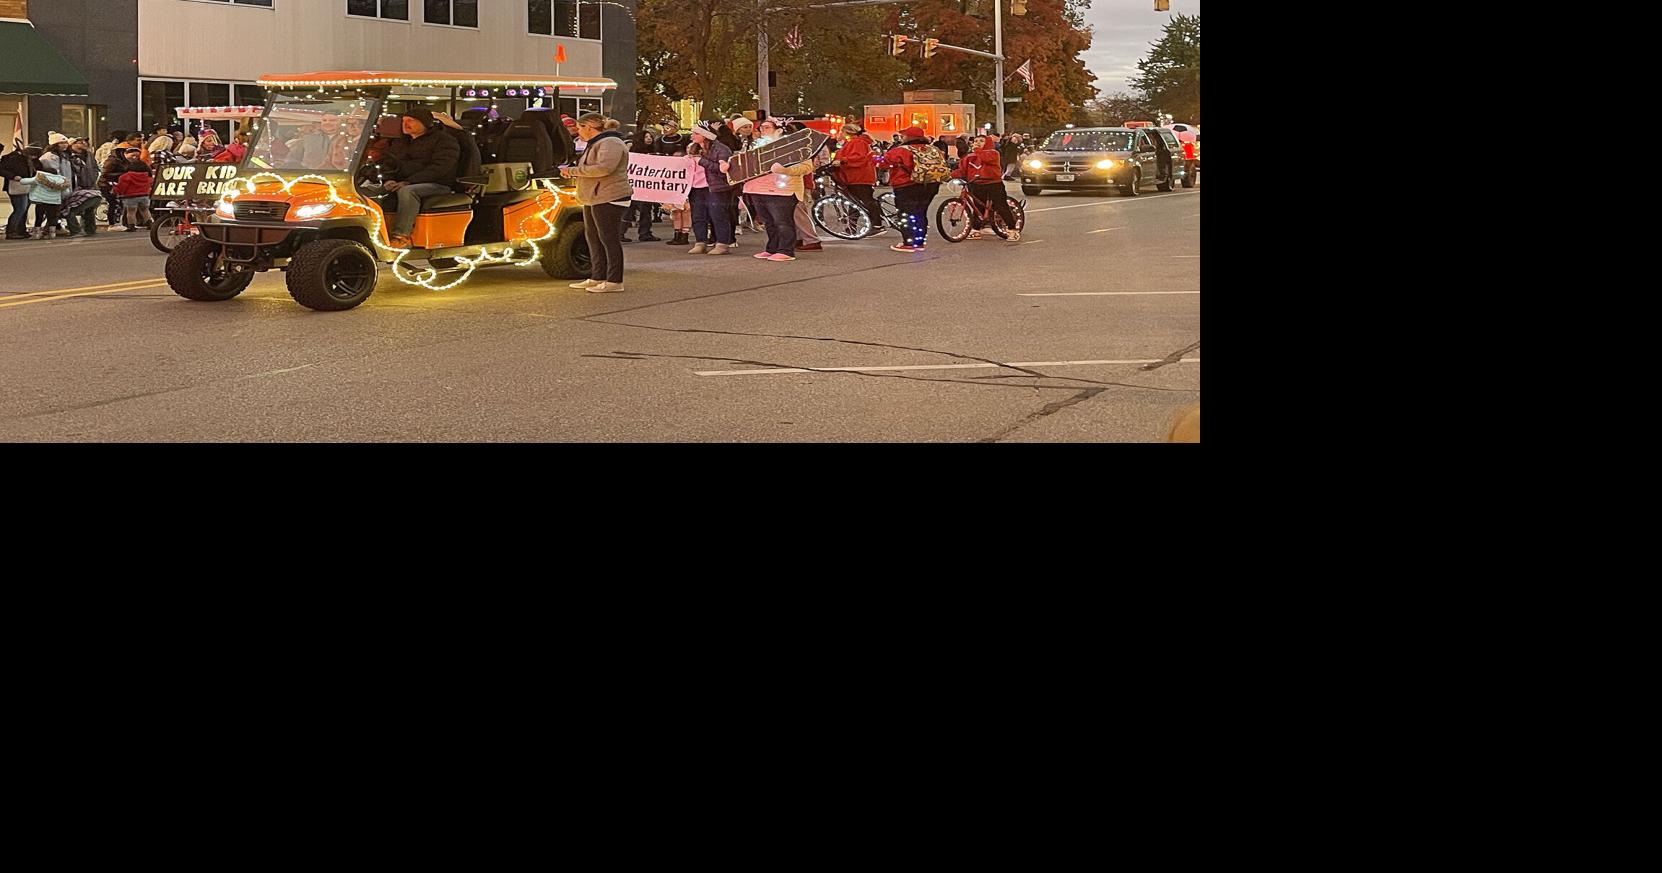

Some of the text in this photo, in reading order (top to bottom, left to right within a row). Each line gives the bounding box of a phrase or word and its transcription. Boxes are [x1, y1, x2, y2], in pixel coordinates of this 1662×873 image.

[162, 165, 237, 180] OUR KID
[627, 163, 686, 180] Waterford
[154, 181, 187, 195] ARE
[628, 178, 688, 194] ementary
